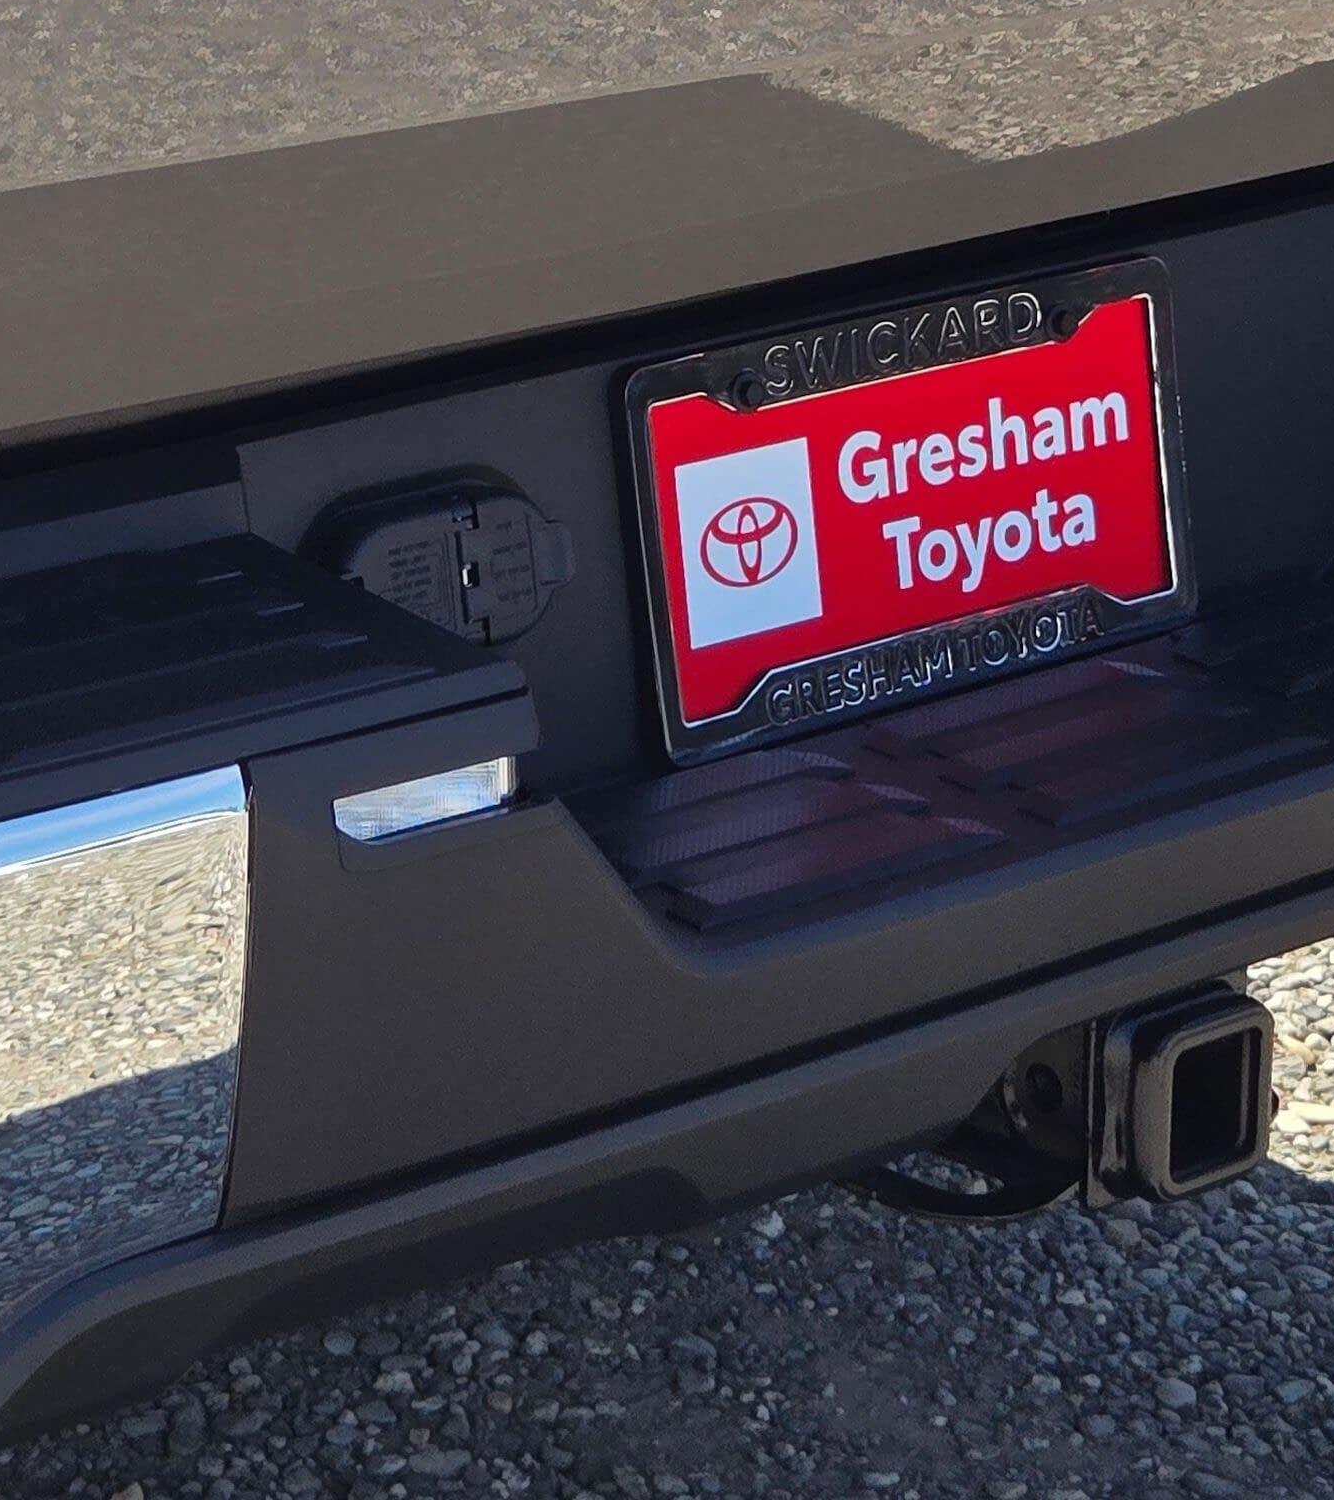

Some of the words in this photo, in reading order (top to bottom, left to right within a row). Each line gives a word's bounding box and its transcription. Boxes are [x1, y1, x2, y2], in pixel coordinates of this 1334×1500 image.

[763, 292, 1043, 397] SWICKARD
[837, 391, 1130, 504] Gresham
[882, 490, 1097, 594] Toyota
[766, 636, 954, 726] GRESHAM
[963, 597, 1105, 672] TOYOTA
